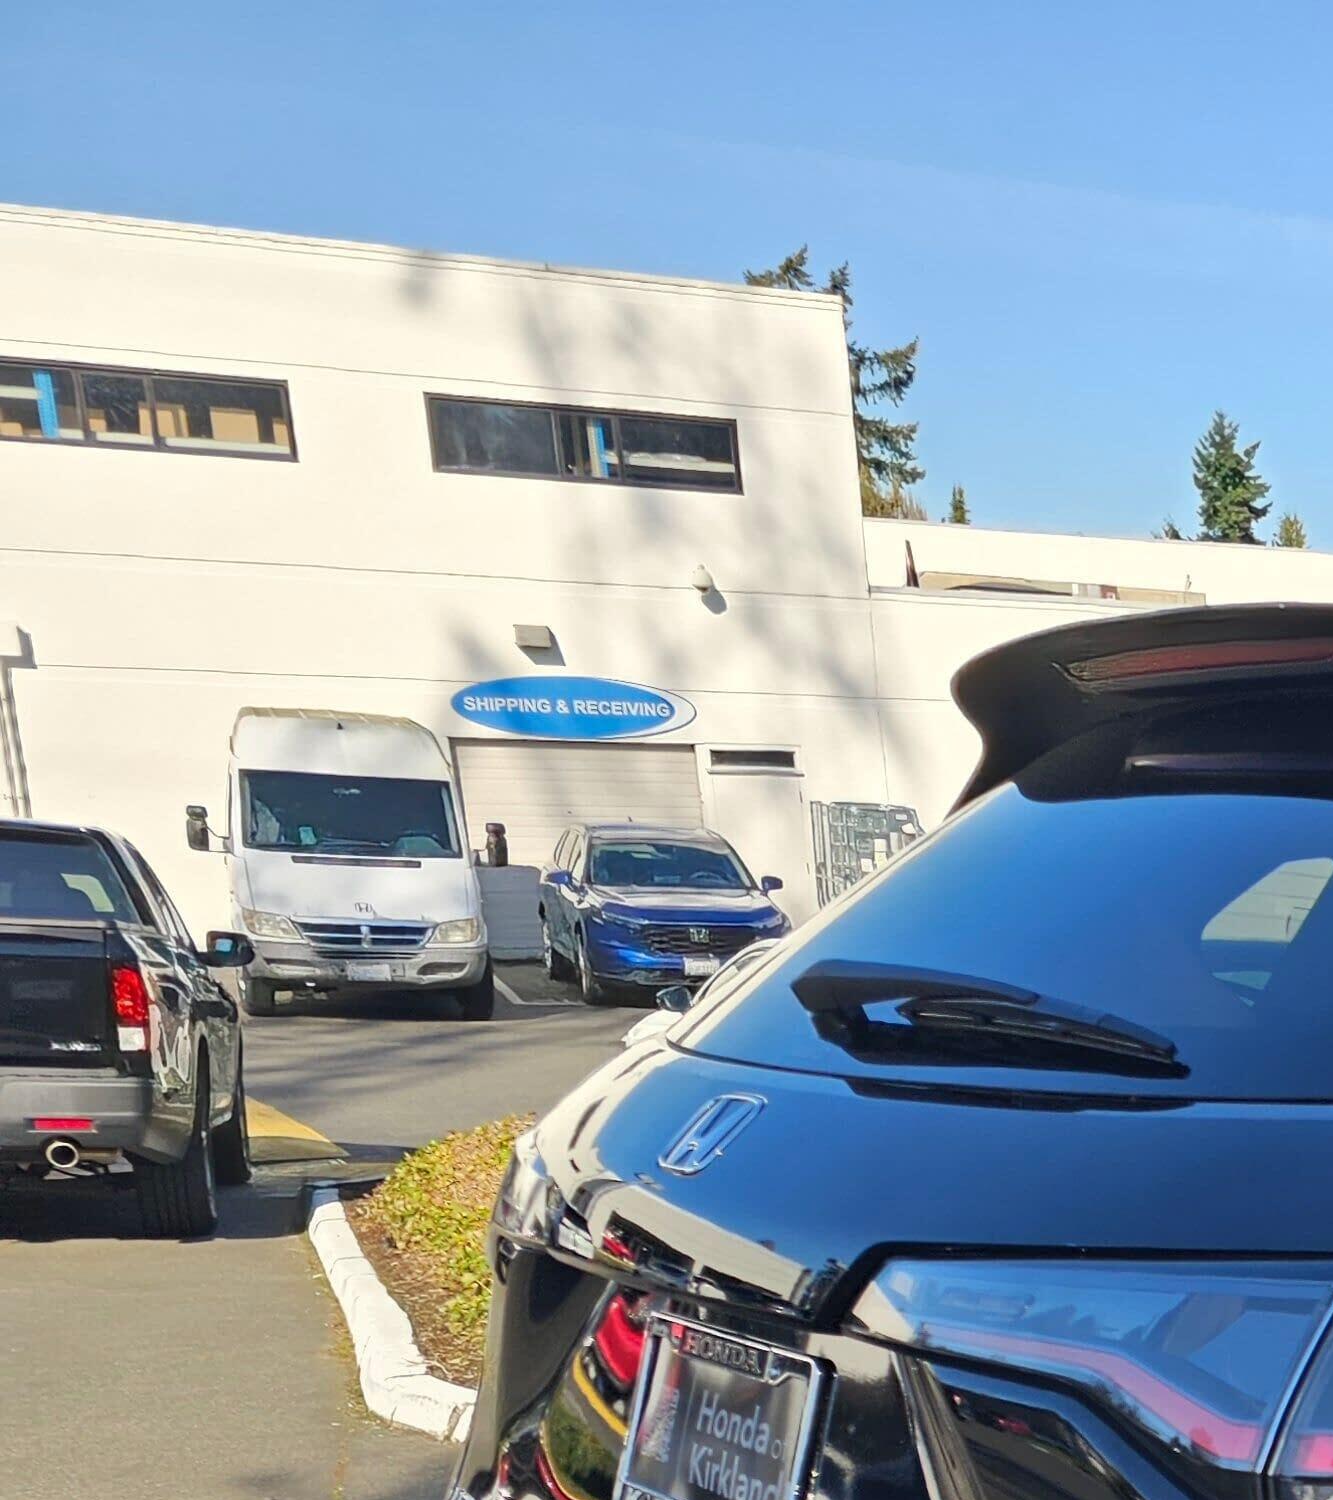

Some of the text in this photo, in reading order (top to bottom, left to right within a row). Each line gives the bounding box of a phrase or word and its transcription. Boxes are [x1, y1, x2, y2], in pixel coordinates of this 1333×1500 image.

[463, 696, 671, 717] SHIPPING & RECEIVING
[697, 1389, 770, 1455] Honda
